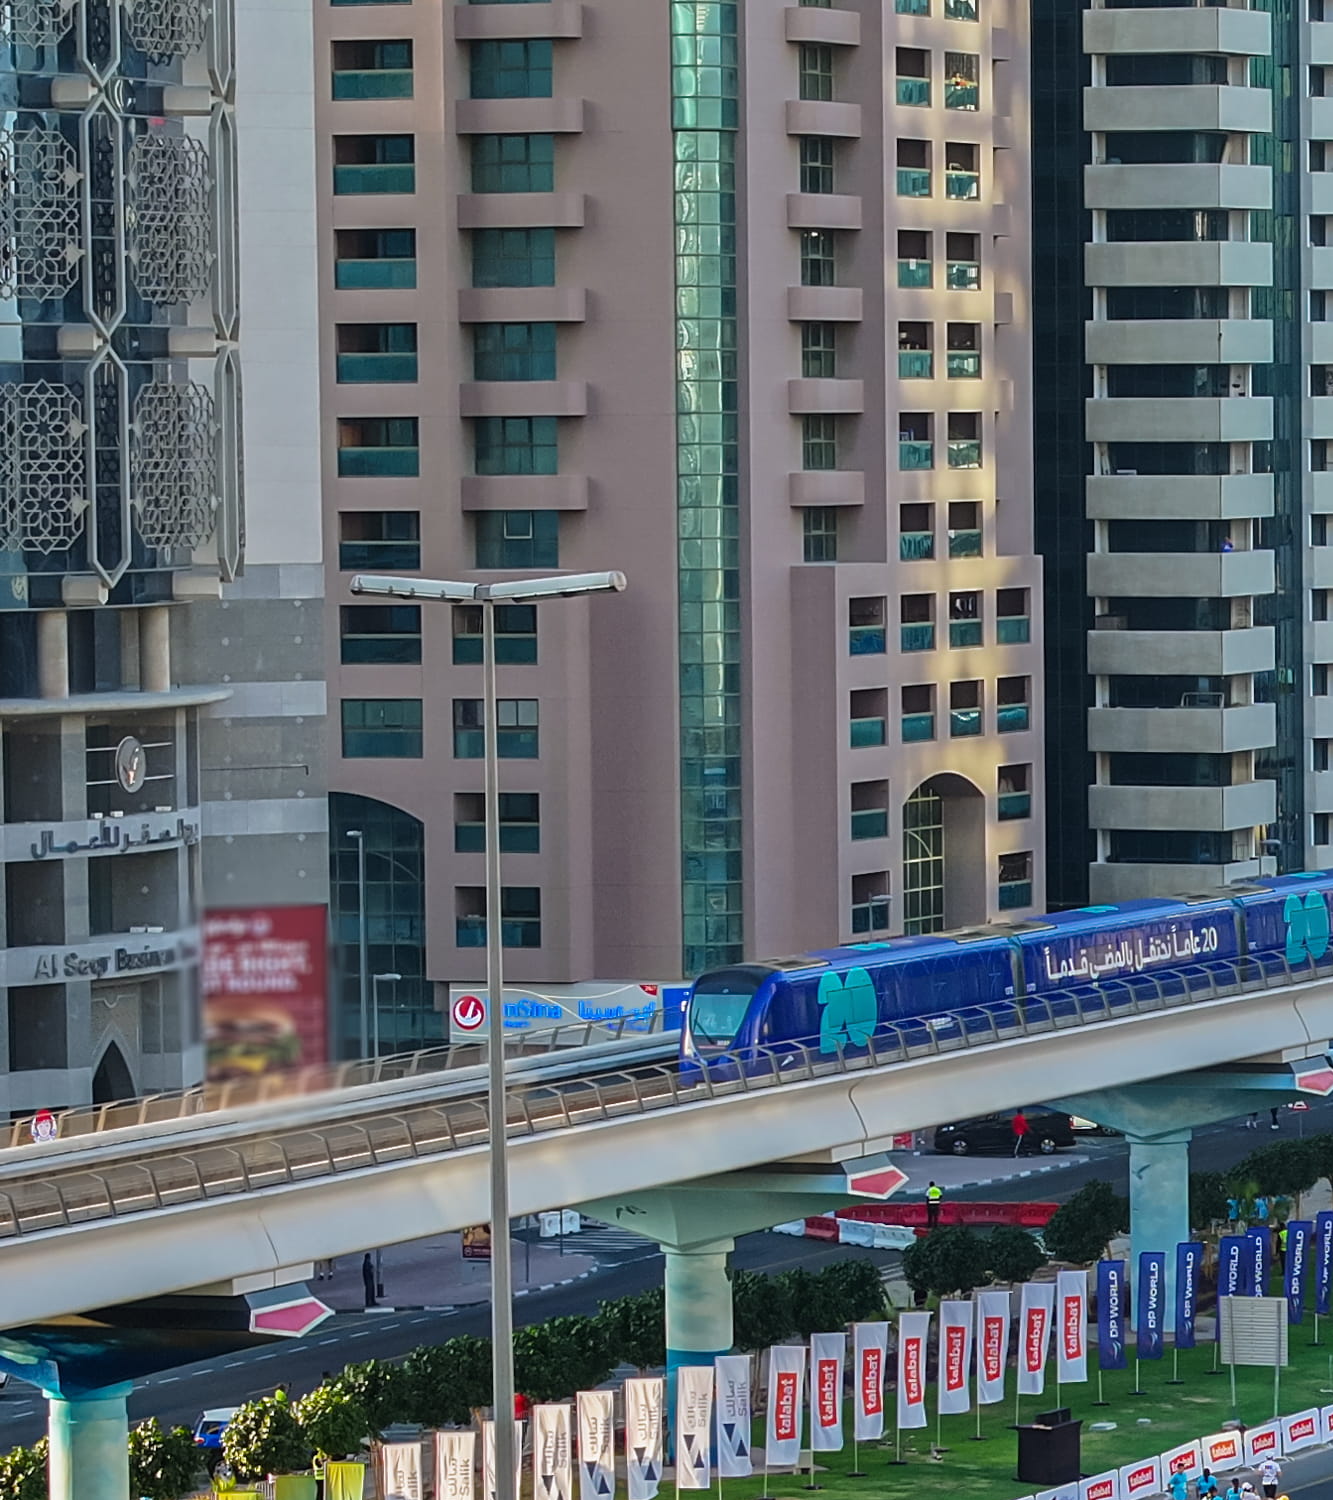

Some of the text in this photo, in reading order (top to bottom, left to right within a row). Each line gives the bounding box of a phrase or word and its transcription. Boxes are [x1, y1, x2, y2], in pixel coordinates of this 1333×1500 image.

[1201, 926, 1218, 953] 20
[1255, 1236, 1263, 1282] WORLD
[1291, 1230, 1304, 1296] DP WORLD
[1109, 1270, 1118, 1338] DP WORLD
[1149, 1261, 1159, 1329] DP WORLD
[986, 1321, 999, 1376] talabat
[1030, 1313, 1042, 1367] talabat
[1068, 1299, 1079, 1355] talabat
[866, 1354, 878, 1410] talabat
[907, 1343, 918, 1399] talabat
[950, 1331, 962, 1386] talabat
[738, 1381, 748, 1417] Salik
[778, 1378, 794, 1436] talabat
[822, 1365, 834, 1422] talabat
[459, 1457, 470, 1497] Salik
